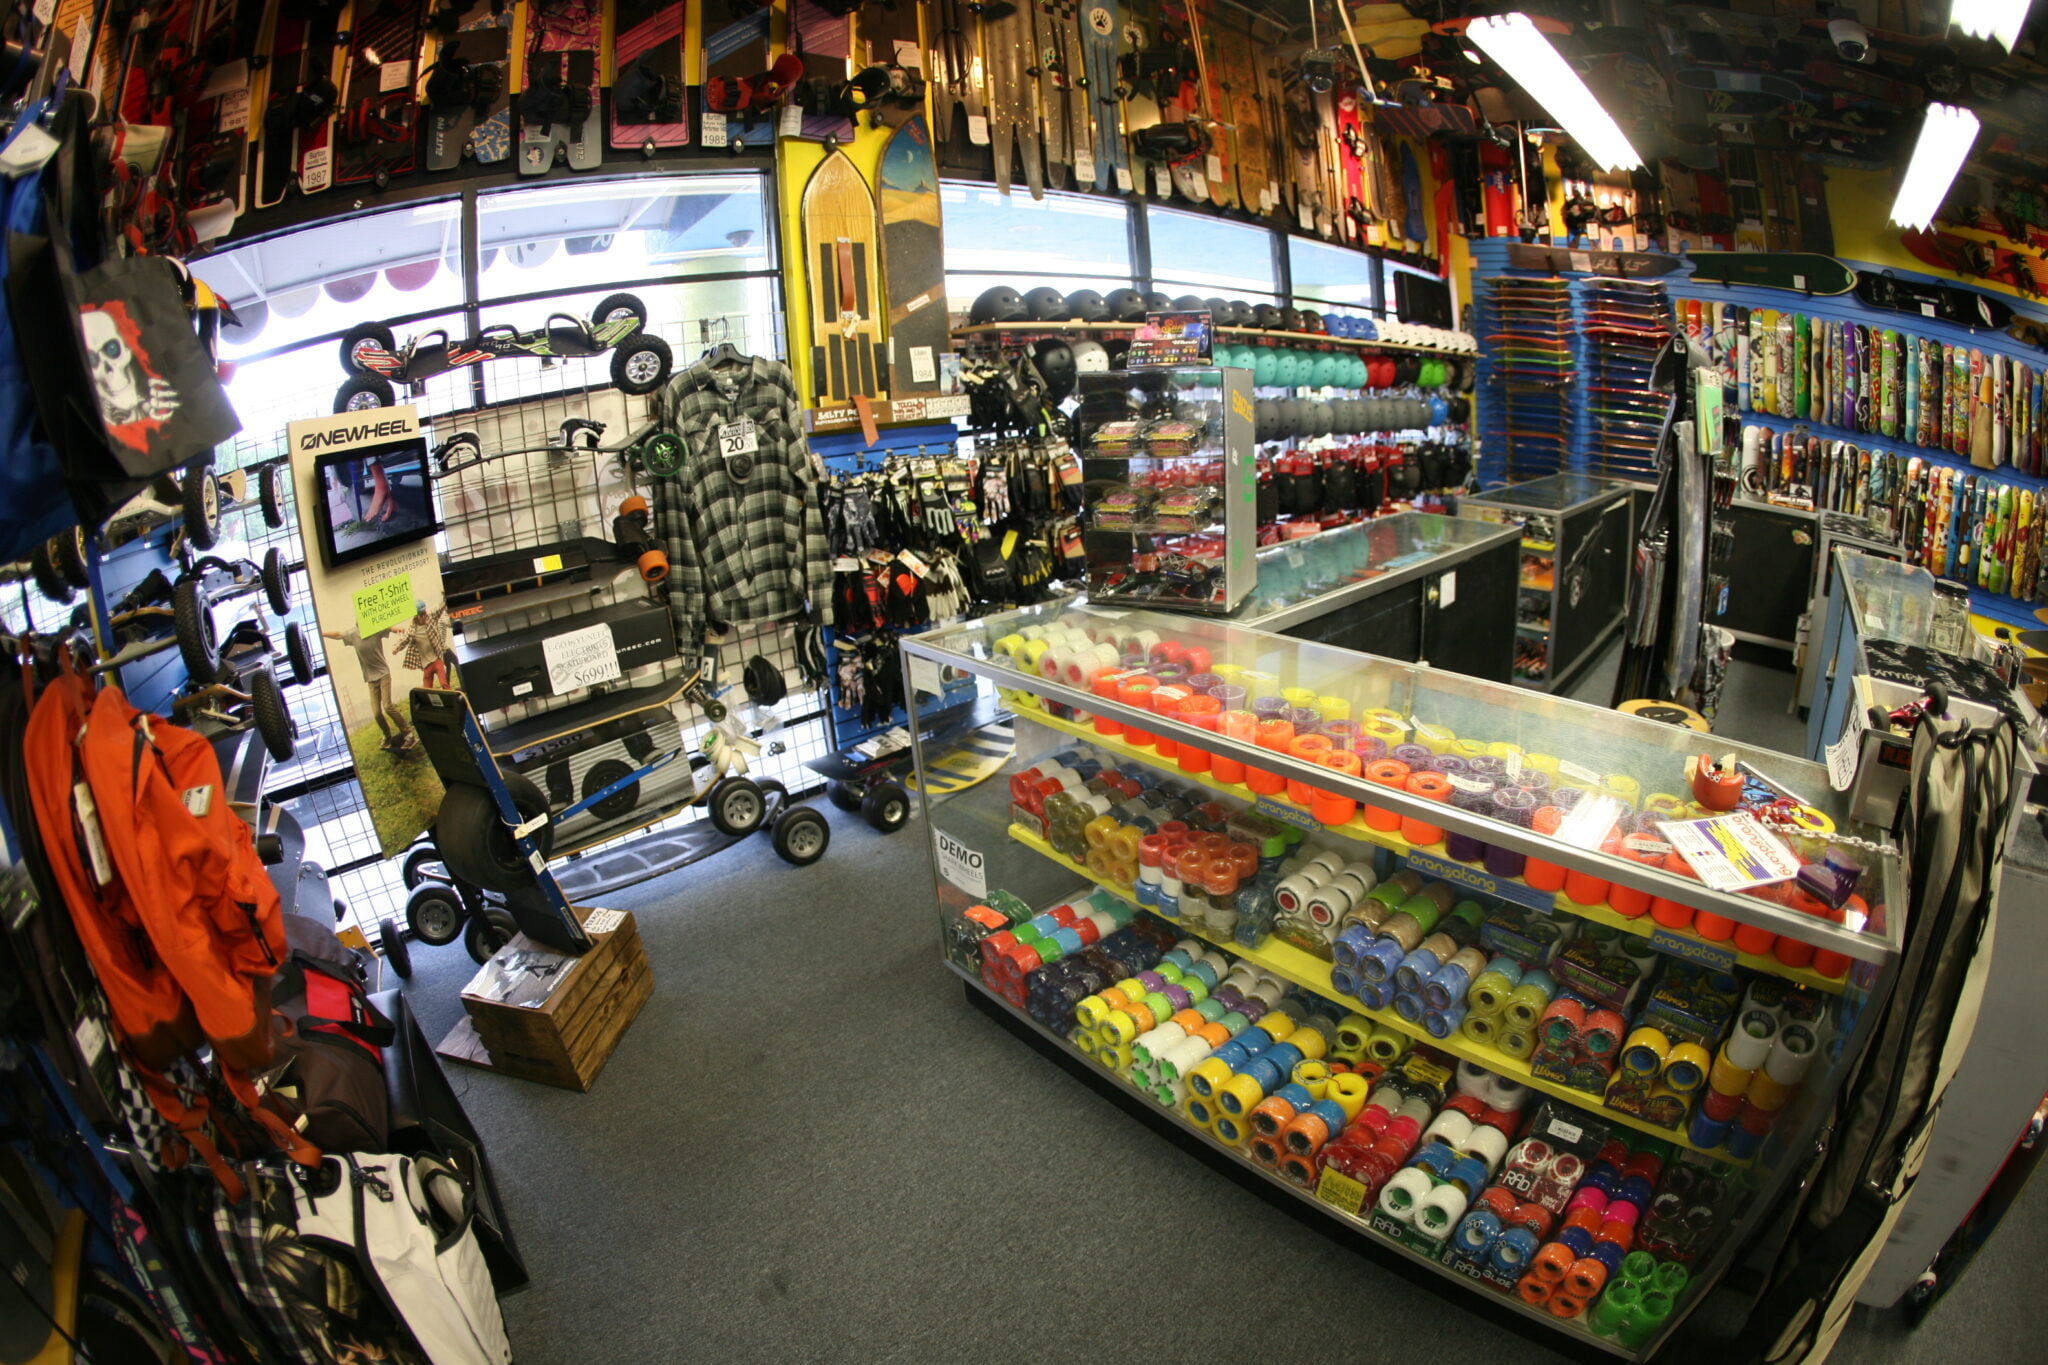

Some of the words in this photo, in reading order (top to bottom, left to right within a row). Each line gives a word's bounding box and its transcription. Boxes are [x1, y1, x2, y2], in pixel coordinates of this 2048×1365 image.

[703, 134, 727, 145] 1985
[309, 150, 326, 160] Burton
[306, 169, 327, 186] 1987
[818, 408, 846, 420] SALTY
[300, 419, 413, 451] ONEWHEEL
[726, 436, 745, 453] 20
[361, 566, 376, 577] THE
[376, 547, 429, 571] REVOLUTIONARY
[363, 571, 393, 588] ELECTRIC
[394, 557, 430, 577] BOARDSPORT
[357, 595, 379, 610] Free
[379, 580, 409, 600] T-Shirt
[361, 607, 379, 619] WITH
[378, 600, 392, 613] ONE
[391, 594, 411, 608] WHEEL
[371, 605, 402, 626] PURCHASE
[574, 660, 621, 687] $699!!!
[1257, 799, 1323, 833] orangatang
[939, 835, 983, 869] DEMO
[1731, 816, 1794, 877] orangatang
[1409, 853, 1498, 894] orangatang
[1653, 934, 1735, 969] orangatang
[1502, 1169, 1531, 1192] RAD
[1373, 1216, 1402, 1238] RAD
[1453, 1260, 1481, 1279] RAD
